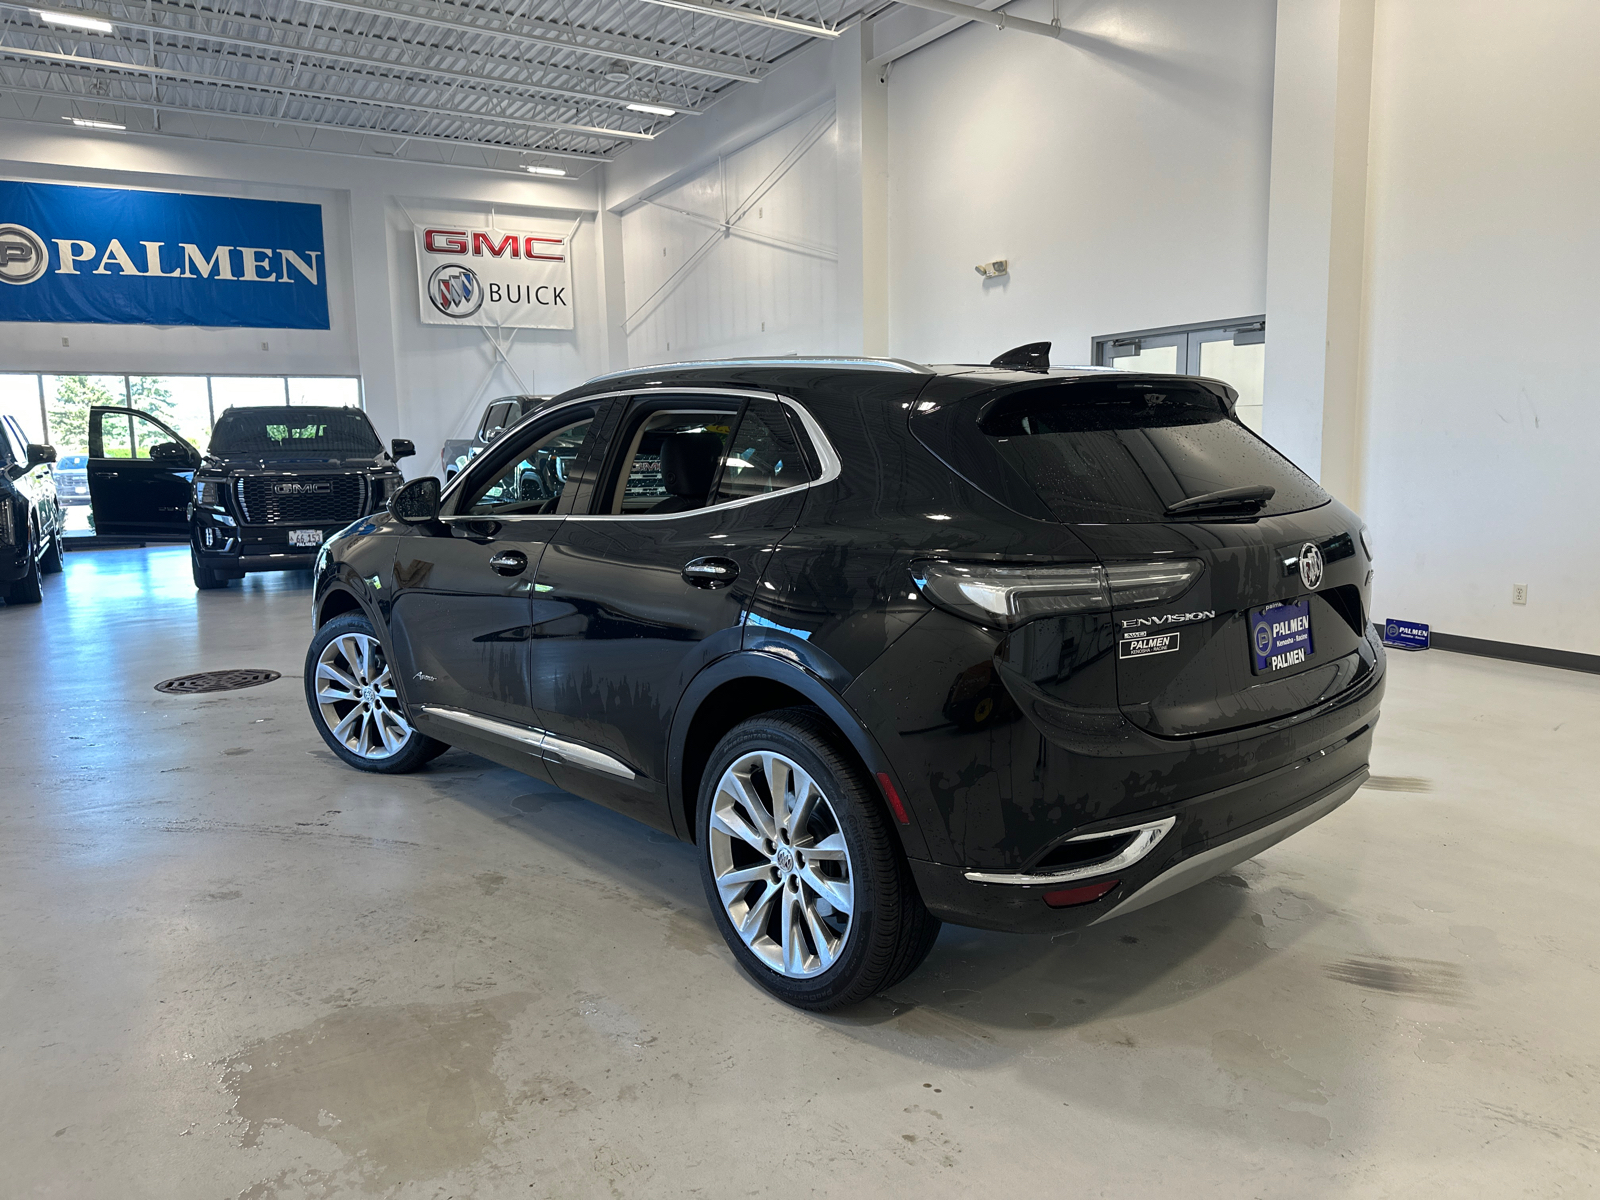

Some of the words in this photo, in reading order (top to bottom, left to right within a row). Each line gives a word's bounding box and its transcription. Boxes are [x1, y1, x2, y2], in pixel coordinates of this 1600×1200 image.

[424, 228, 565, 262] GMC
[51, 239, 321, 285] PALMEN
[489, 283, 567, 306] BUICK
[274, 483, 331, 494] GMC
[1122, 610, 1215, 628] ENVISION
[1273, 615, 1308, 637] PALMEN
[1399, 627, 1428, 637] PALMEN
[1130, 636, 1170, 650] PALMEN
[1277, 638, 1293, 647] Kenosha
[1272, 648, 1304, 670] PALMEN
